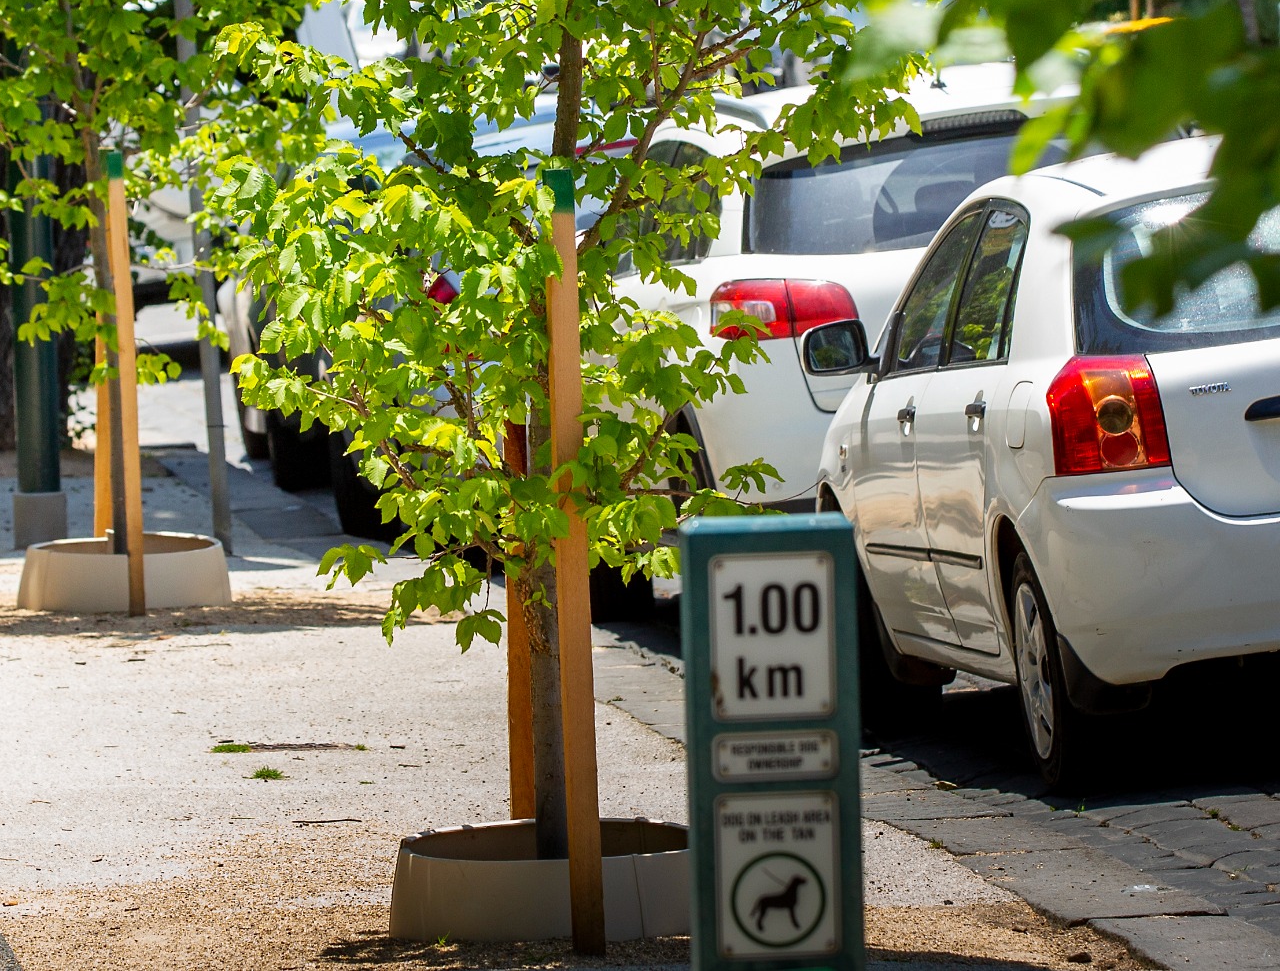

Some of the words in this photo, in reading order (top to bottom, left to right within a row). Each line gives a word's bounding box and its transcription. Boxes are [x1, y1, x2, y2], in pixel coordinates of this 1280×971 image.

[1189, 382, 1232, 396] TOYOTA
[723, 583, 820, 635] 1.00
[737, 656, 804, 699] km
[731, 741, 795, 756] RESPONSIBLE
[722, 812, 744, 826] DOG
[747, 812, 762, 825] ON
[765, 811, 800, 824] LEASH
[802, 810, 830, 823] AREA
[739, 829, 756, 842] ON
[763, 828, 784, 840] THE
[792, 827, 815, 840] TAN
